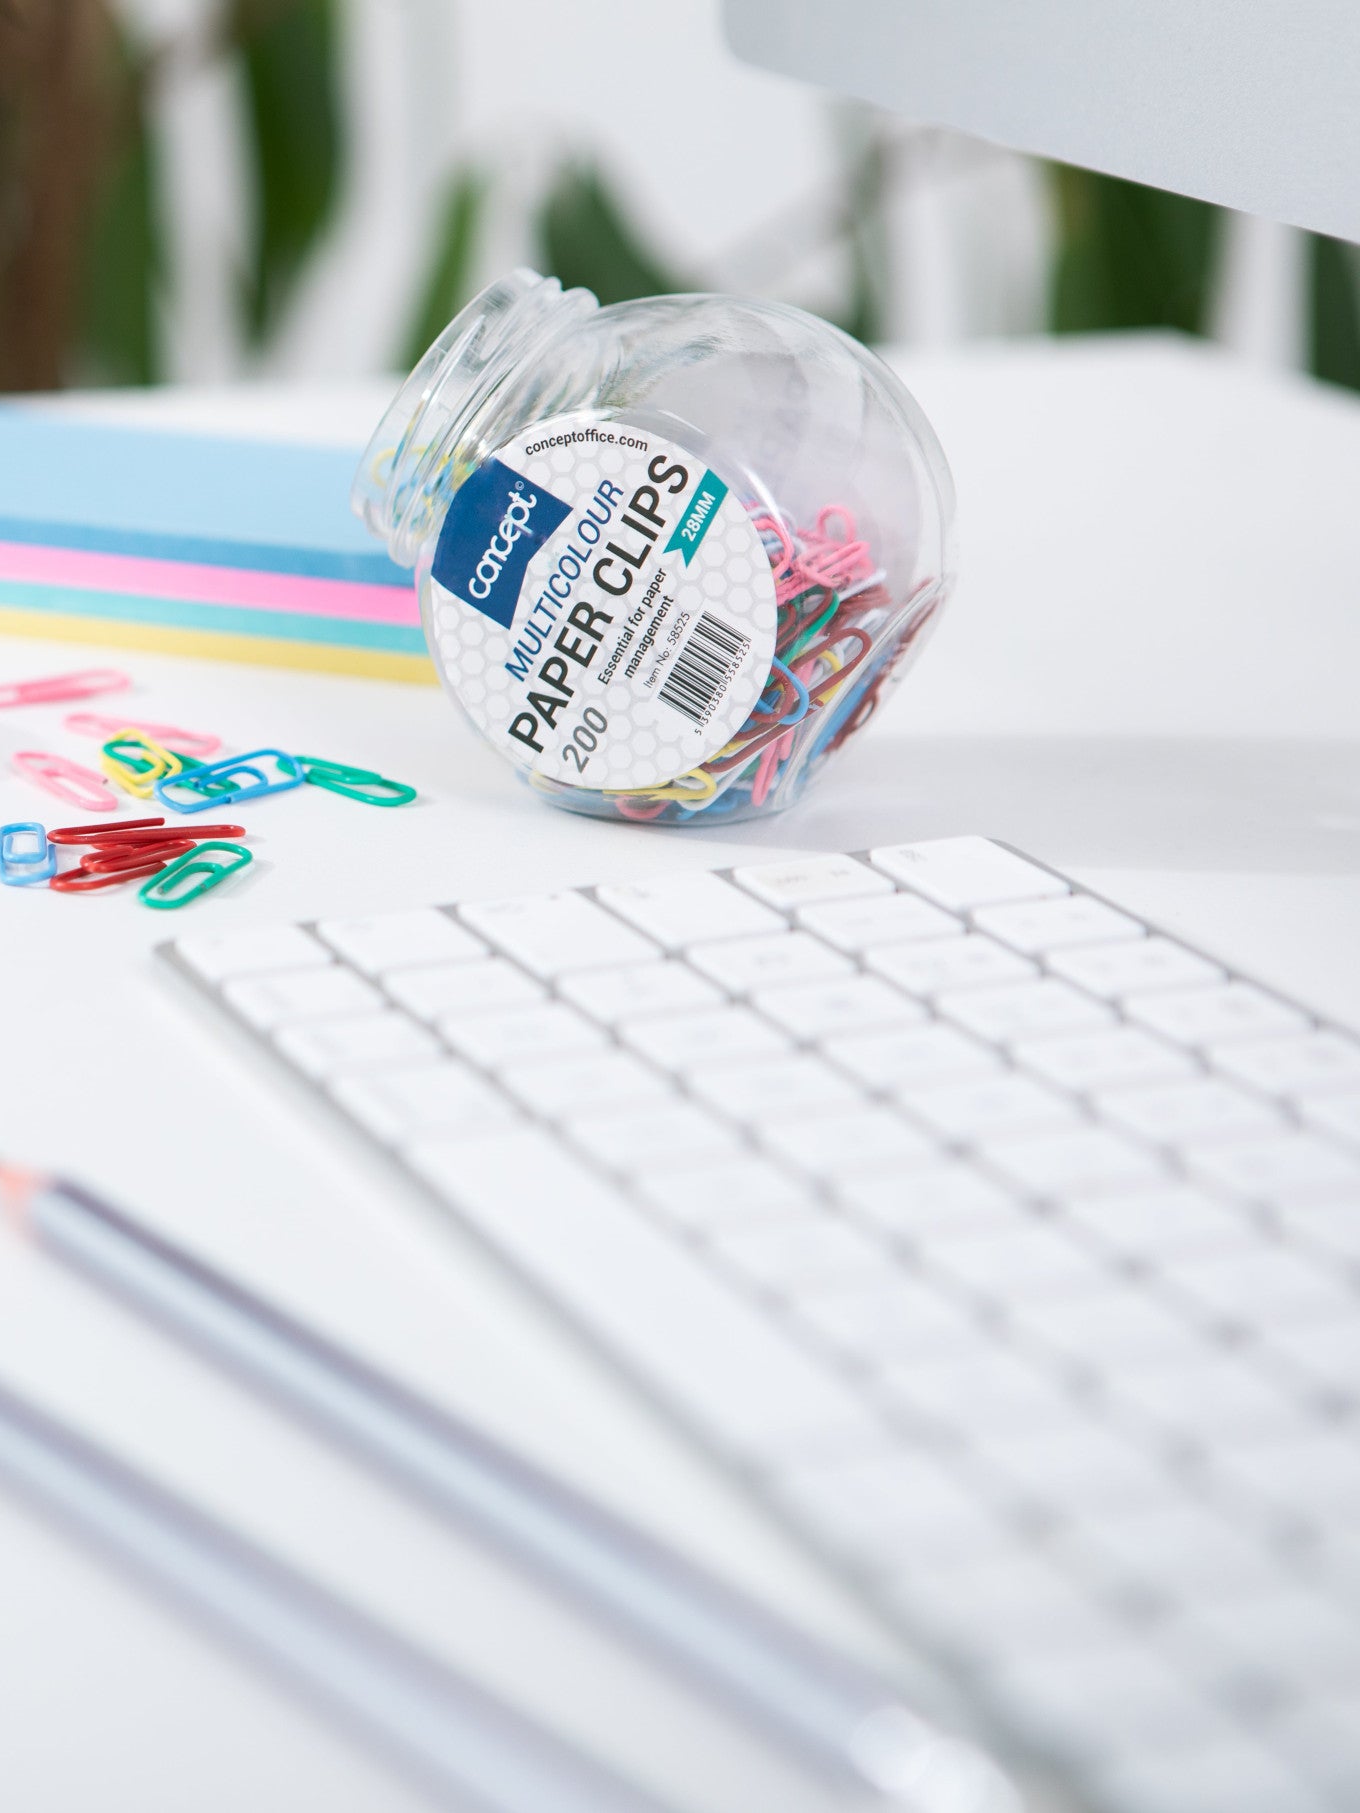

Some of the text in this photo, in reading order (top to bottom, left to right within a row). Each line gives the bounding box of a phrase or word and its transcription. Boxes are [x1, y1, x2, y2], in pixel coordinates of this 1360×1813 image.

[525, 428, 648, 456] conceptoffice.com
[681, 490, 716, 542] 28MM
[504, 479, 624, 682] MULTICOLOUR
[508, 455, 689, 753] PAPER CLIPS
[597, 568, 667, 685] Essential for paper
[624, 595, 674, 679] management
[643, 611, 690, 689] Item No: 58525
[562, 707, 608, 774] 200
